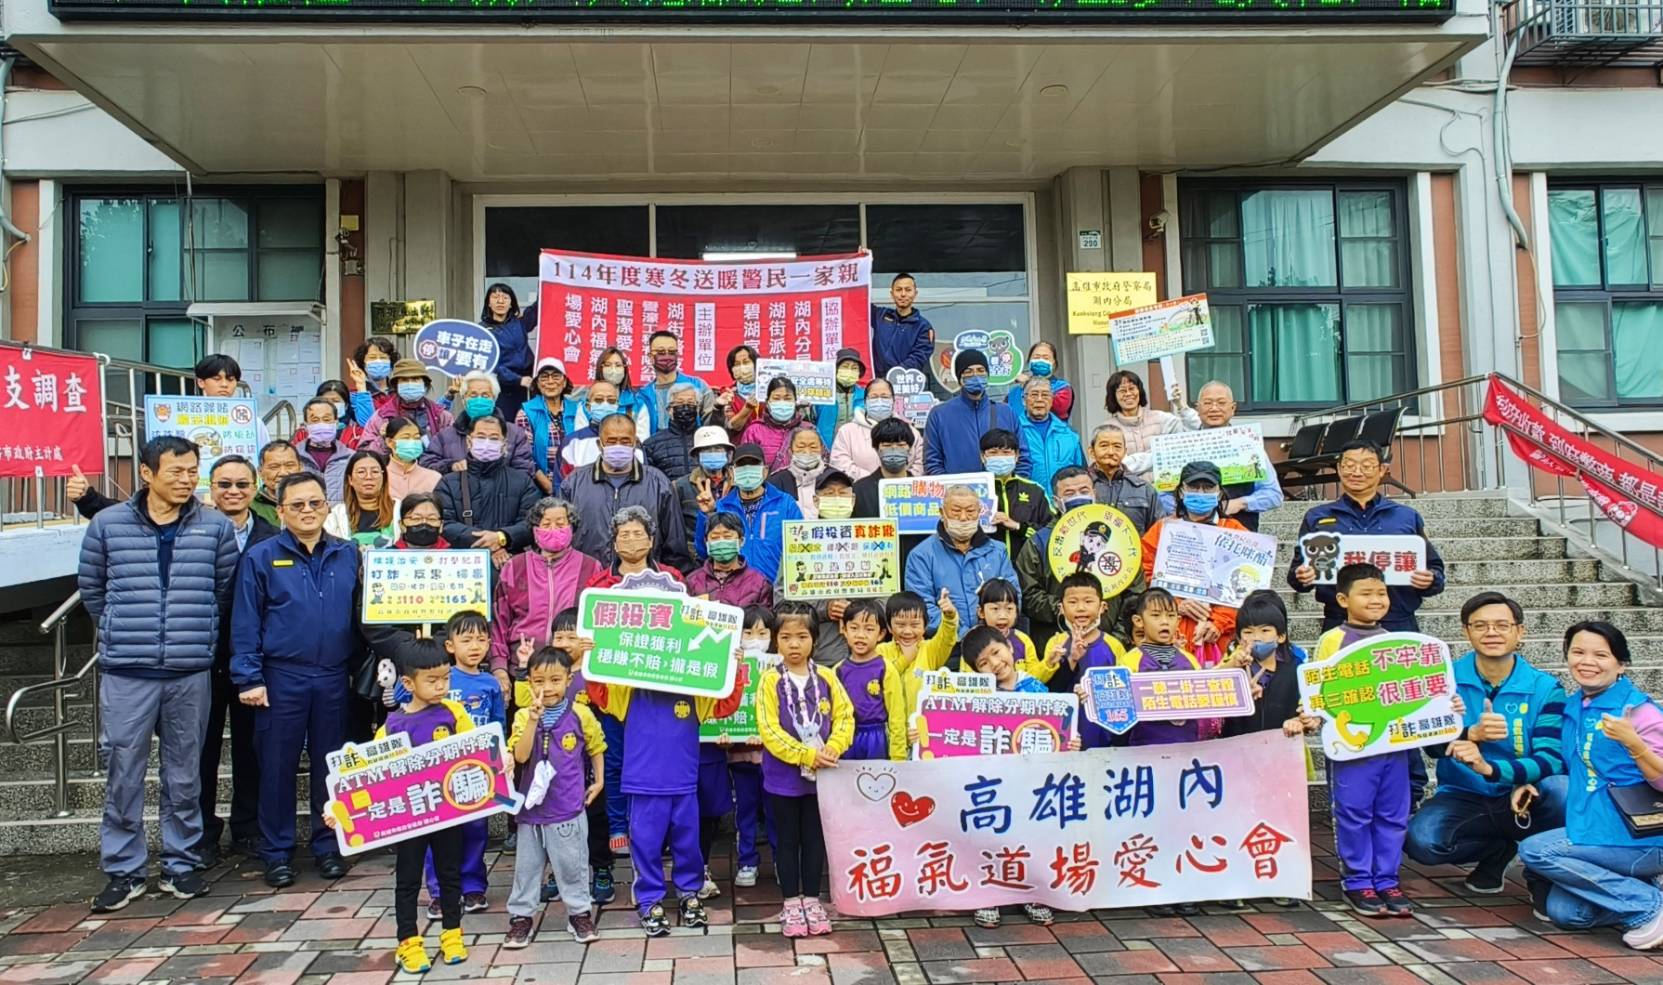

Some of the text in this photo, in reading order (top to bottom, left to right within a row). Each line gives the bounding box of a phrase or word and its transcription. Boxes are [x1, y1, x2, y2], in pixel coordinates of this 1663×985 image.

[553, 262, 859, 291] 114年度寒冬送暖警民一家親
[1071, 281, 1152, 291] 高雄市政府警察局
[564, 294, 583, 362] 場愛心會
[698, 308, 712, 367] 主辦單位
[592, 602, 674, 629] 假投資
[619, 632, 682, 653] 保證獲利
[1303, 643, 1443, 685] 陌生電話 不牢靠
[1310, 674, 1449, 711] 再三確認 很重要
[350, 766, 489, 821] 一定是詐騙
[961, 758, 1224, 834] 高雄湖內
[848, 822, 1298, 901] 福氣道場愛心會
